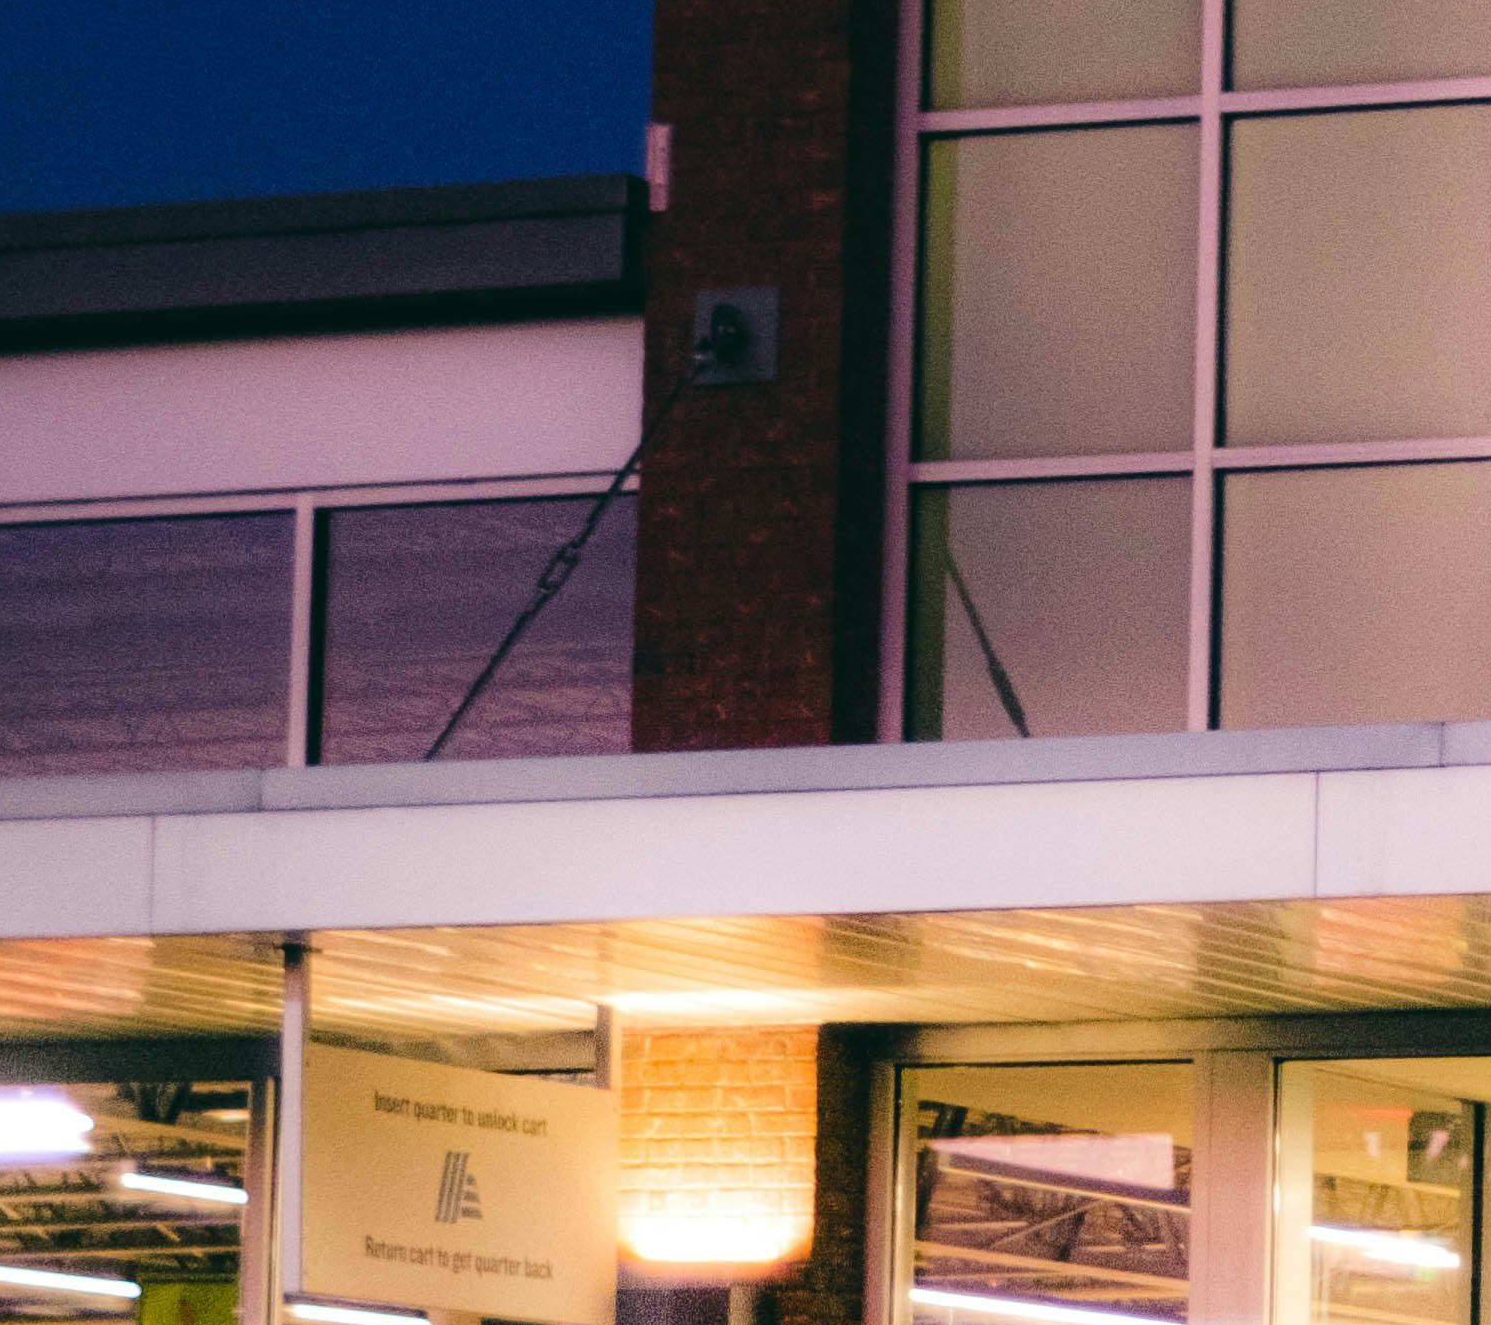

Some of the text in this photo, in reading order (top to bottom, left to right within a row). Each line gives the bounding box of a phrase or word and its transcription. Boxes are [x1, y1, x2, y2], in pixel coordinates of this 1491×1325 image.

[374, 1091, 548, 1137] Insert quarter to unlock cart
[365, 1235, 554, 1279] Return cart to get quarter back
